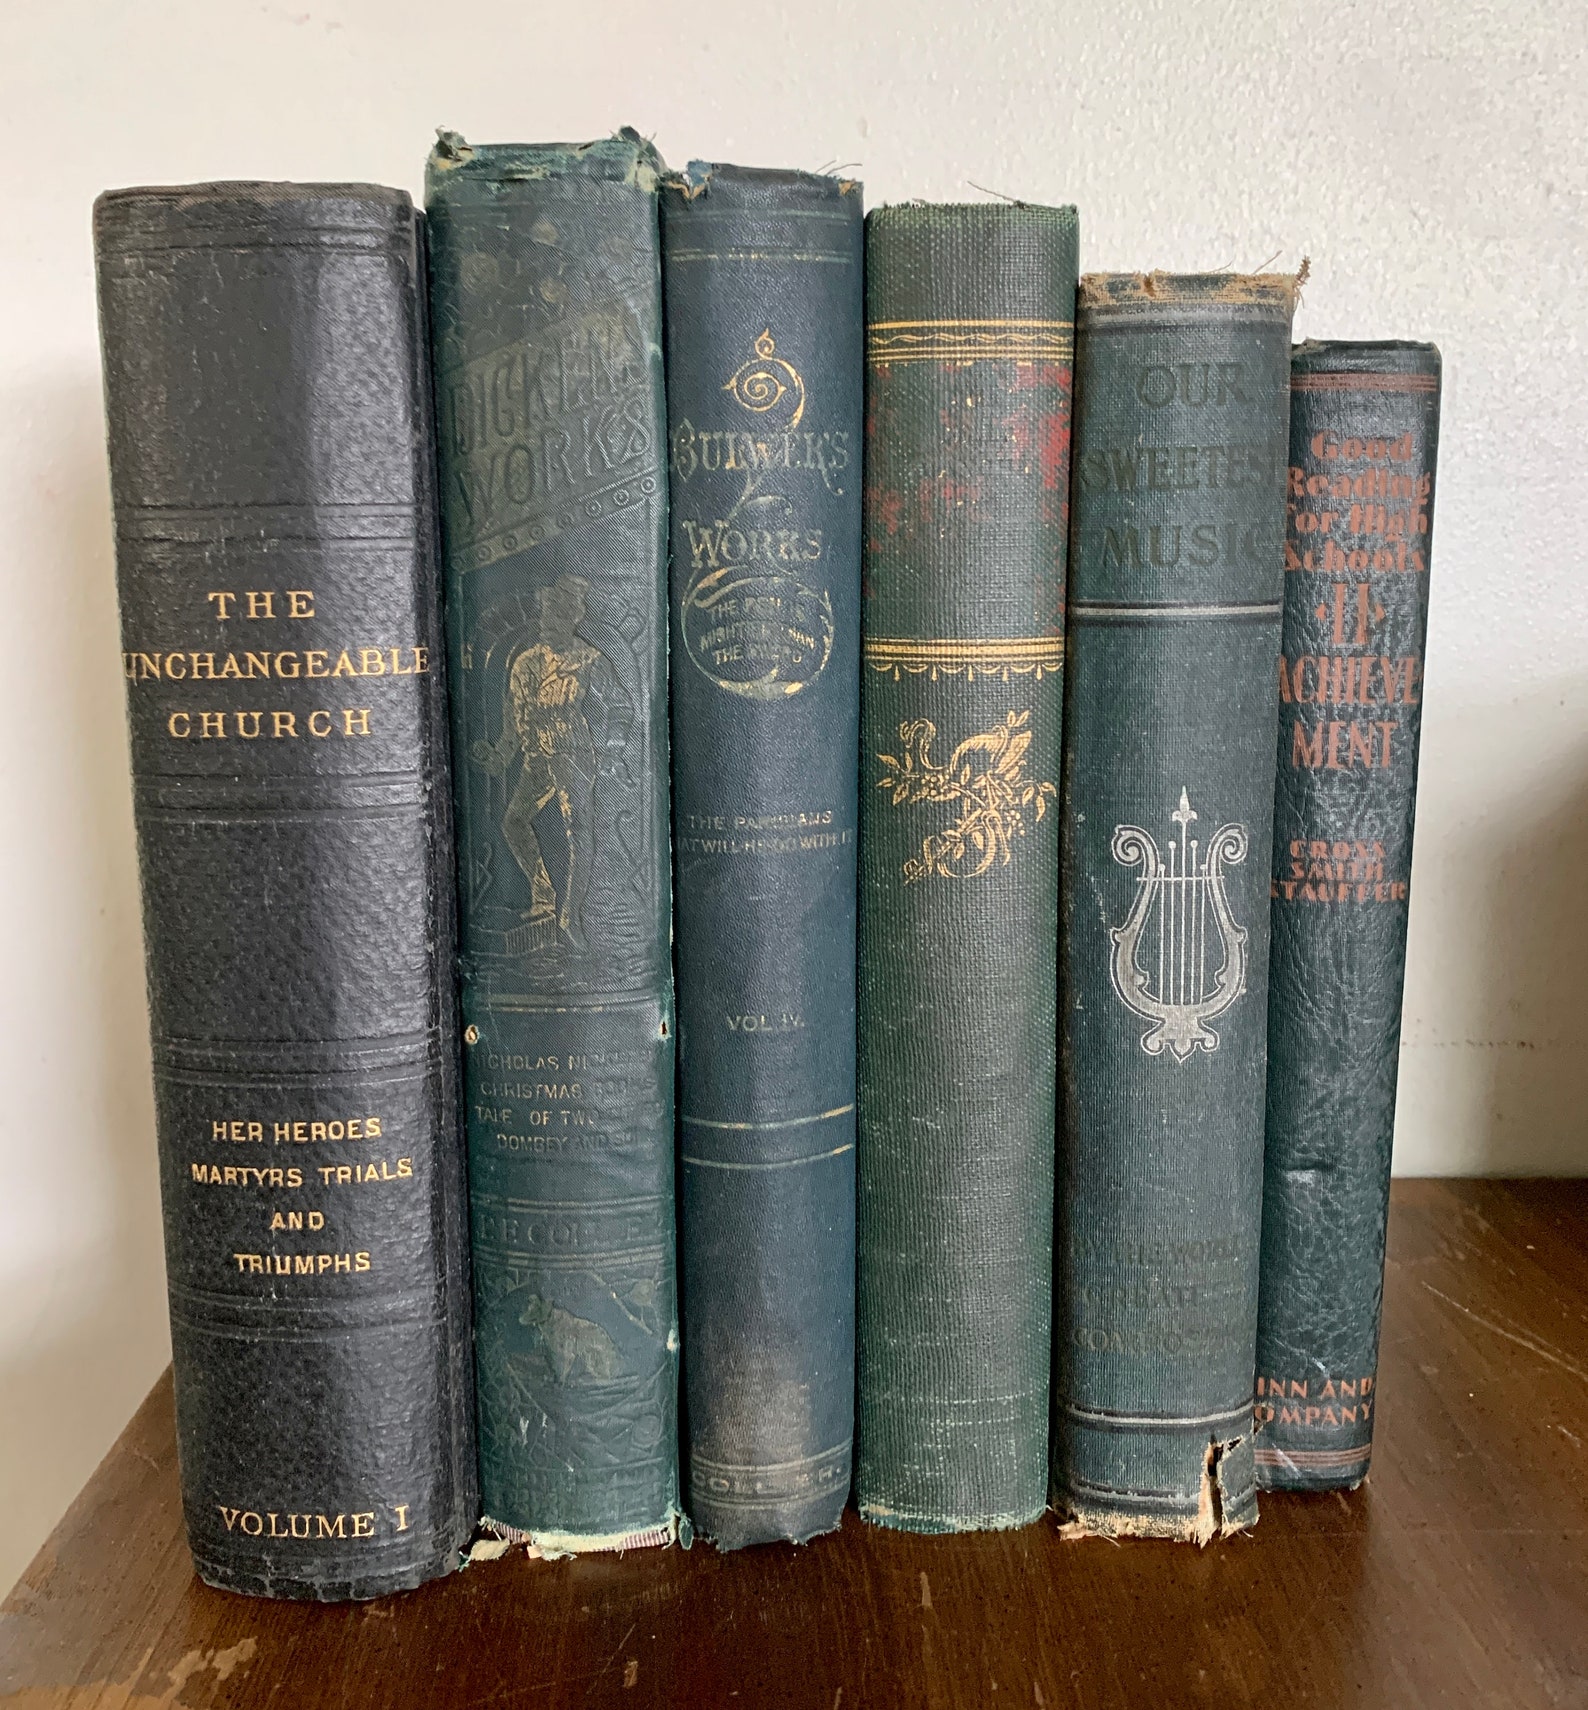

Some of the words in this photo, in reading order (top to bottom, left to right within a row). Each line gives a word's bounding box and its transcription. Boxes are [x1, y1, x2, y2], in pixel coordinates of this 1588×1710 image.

[1136, 362, 1252, 410] OUR
[1311, 429, 1412, 461] Good
[682, 519, 823, 568] WORKS
[208, 590, 316, 620] THE
[122, 646, 430, 680] UNCHANGEABLE
[168, 710, 372, 738] CHURCH
[1292, 721, 1398, 769] MENT
[212, 1121, 263, 1142] HER
[274, 1117, 382, 1143] HEROES
[529, 1109, 552, 1127] OF
[191, 1163, 303, 1188] MARTYRS
[318, 1157, 414, 1185] TRIALS
[270, 1211, 326, 1232] AND
[233, 1252, 372, 1276] TRIUMPHS
[1257, 1377, 1308, 1399] INN
[1321, 1377, 1373, 1400] AND
[1254, 1402, 1370, 1426] OMPANY
[220, 1506, 376, 1539] VOLUME
[395, 1505, 411, 1532] I
